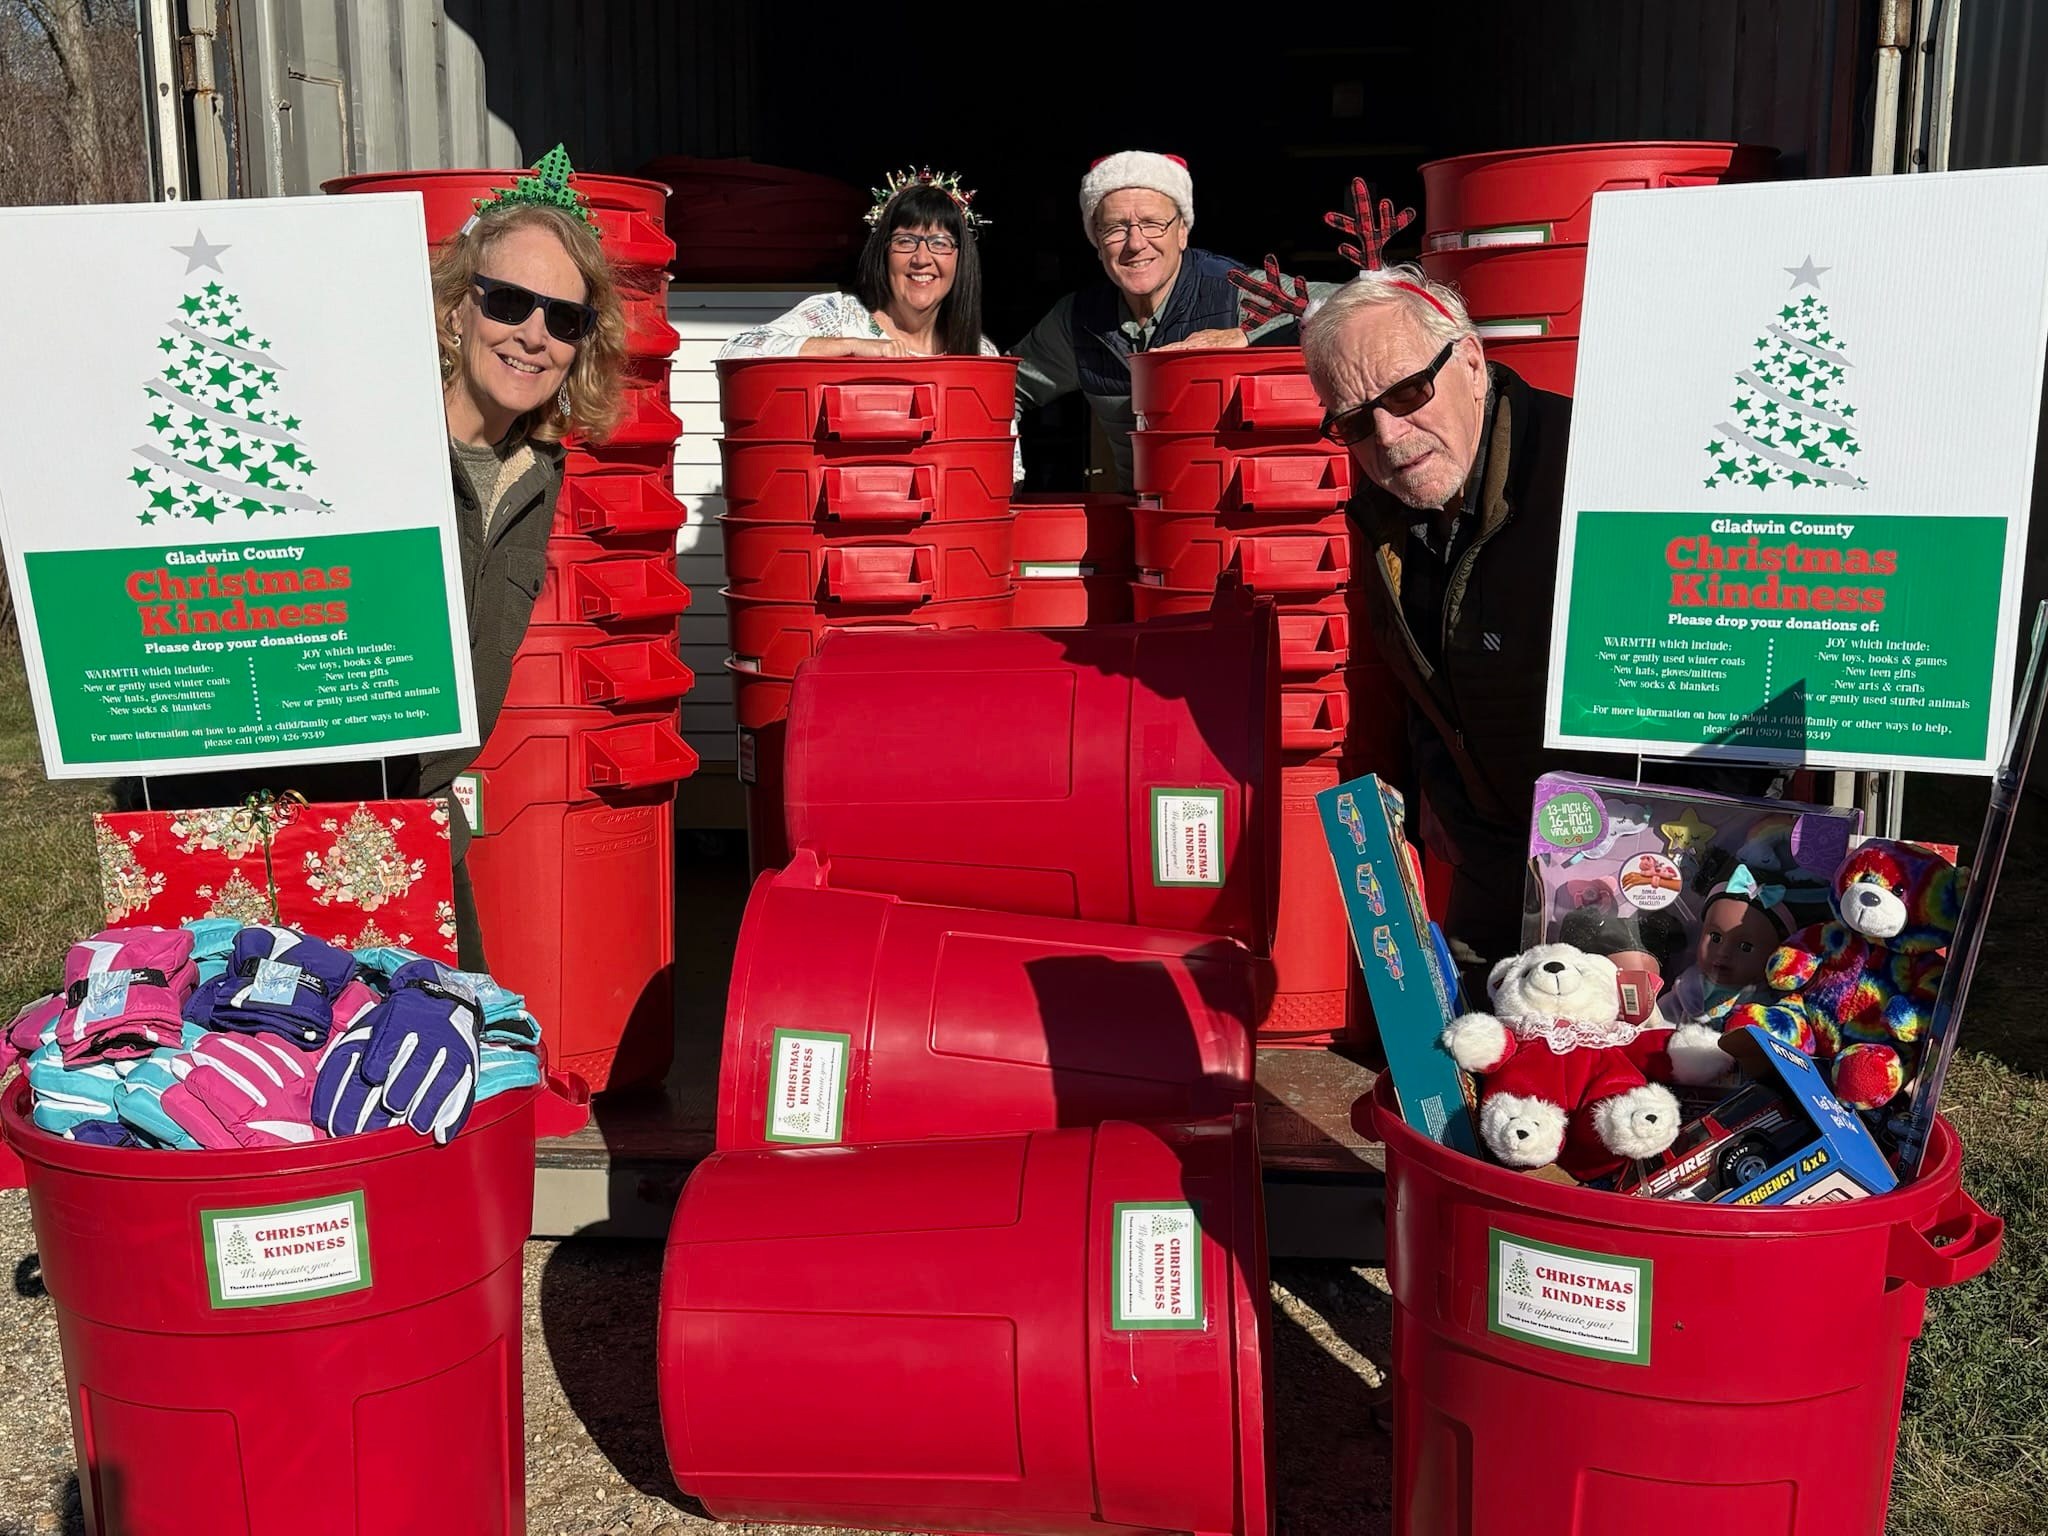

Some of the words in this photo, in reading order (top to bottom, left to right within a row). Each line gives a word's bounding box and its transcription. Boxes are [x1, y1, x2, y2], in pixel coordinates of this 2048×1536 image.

[1711, 519, 1785, 535] Gladwin
[1789, 521, 1854, 539] County
[166, 549, 240, 565] Gladwin
[243, 546, 305, 561] County
[1666, 535, 1898, 575] Christmas
[126, 566, 351, 602] Christmas
[1669, 573, 1885, 612] Kindness
[139, 599, 348, 636] Kindness
[1668, 613, 1713, 626] Please
[1715, 614, 1748, 629] drop
[1751, 619, 1782, 630] your
[1785, 618, 1857, 632] donations
[1860, 620, 1880, 632] of:
[145, 643, 189, 654] Please
[192, 640, 224, 653] drop
[227, 638, 257, 650] your
[260, 632, 328, 647] donations
[330, 630, 348, 641] of:
[302, 649, 321, 660] JOY
[325, 646, 354, 657] which
[357, 643, 396, 654] include:
[1604, 636, 1656, 648] WARMTH
[1659, 639, 1688, 650] which
[1691, 640, 1732, 651] include:
[1825, 637, 1847, 649] JOY
[1851, 639, 1883, 650] which
[1886, 640, 1930, 652] include:
[320, 660, 341, 671] toys,
[343, 658, 371, 668] books
[374, 657, 383, 665] &
[385, 654, 414, 665] games
[1620, 653, 1630, 661] or
[1632, 653, 1660, 665] gently
[1663, 655, 1685, 663] used
[1687, 655, 1718, 665] winter
[1721, 657, 1746, 666] coats
[1842, 653, 1865, 664] toys,
[1868, 653, 1899, 665] books
[1902, 656, 1911, 665] &
[1915, 656, 1948, 667] games
[85, 668, 139, 679] WARMTH
[142, 666, 172, 676] which
[174, 664, 214, 675] include:
[347, 671, 367, 679] teen
[369, 668, 389, 680] gifts
[1635, 666, 1658, 676] hats,
[1661, 668, 1727, 679] gloves/mittens
[1870, 667, 1891, 678] teen
[1894, 668, 1916, 680] gifts
[106, 683, 115, 691] or
[119, 681, 146, 693] gently
[149, 681, 171, 689] used
[174, 678, 203, 687] winter
[206, 677, 231, 686] coats
[340, 683, 359, 692] arts
[361, 681, 370, 690] &
[373, 679, 399, 689] crafts
[1640, 679, 1665, 689] socks
[1668, 681, 1676, 690] &
[1680, 681, 1720, 692] blankets
[1858, 681, 1879, 691] arts
[1882, 682, 1892, 691] &
[1895, 682, 1925, 693] crafts
[124, 693, 149, 702] hats,
[151, 690, 215, 703] gloves/mittens
[304, 699, 314, 707] or
[317, 695, 344, 708] gently
[346, 694, 368, 703] used
[370, 690, 402, 701] stuffed
[404, 686, 440, 697] animals
[1816, 692, 1827, 701] or
[1830, 693, 1860, 706] gently
[1863, 695, 1887, 705] used
[1890, 695, 1925, 707] stuffed
[1928, 697, 1971, 709] animals
[132, 705, 157, 714] socks
[160, 704, 169, 713] &
[172, 702, 212, 712] blankets
[91, 733, 107, 742] For
[110, 733, 132, 741] more
[135, 729, 189, 740] information
[191, 728, 203, 736] on
[205, 727, 224, 735] how
[227, 726, 236, 734] to
[239, 723, 264, 735] adopt
[275, 719, 329, 730] child/family
[344, 715, 368, 725] other
[371, 712, 392, 722] ways
[394, 711, 403, 719] to
[406, 708, 429, 719] help.
[1593, 705, 1608, 714] For
[1611, 707, 1634, 715] more
[1636, 707, 1690, 719] information
[1693, 712, 1704, 720] on
[1708, 711, 1726, 721] how
[1729, 712, 1739, 721] to
[1742, 713, 1768, 725] adopt
[1780, 715, 1838, 729] child/family
[1841, 719, 1853, 728] or
[1856, 719, 1882, 730] other
[1885, 722, 1909, 732] ways
[1911, 722, 1922, 731] to
[1925, 723, 1952, 735] help.
[204, 737, 232, 748] please
[235, 736, 252, 745] call
[255, 731, 280, 745] (989)
[1703, 724, 1733, 736] please
[1735, 725, 1752, 736] call
[1546, 803, 1580, 815] 13-INCH
[1582, 802, 1591, 812] &
[1572, 825, 1593, 834] DOLLS
[1185, 826, 1195, 876] KINDNESS
[1198, 823, 1208, 879] CHRISTMAS
[786, 1042, 801, 1109] CHRISTMAS
[800, 1048, 813, 1105] KINDNESS
[1668, 1152, 1711, 1183] FIRE
[1726, 1146, 1749, 1170] NYLINT
[255, 1217, 350, 1242] CHRISTMAS
[264, 1236, 346, 1258] KINDNESS
[241, 1267, 257, 1279] We
[258, 1264, 309, 1280] appreciate
[1154, 1243, 1165, 1310] KINDNESS
[1170, 1238, 1181, 1314] CHRISTMAS
[1535, 1266, 1633, 1295] CHRISTMAS
[1542, 1286, 1626, 1313] KINDNESS
[1517, 1301, 1534, 1312] We
[1534, 1308, 1585, 1325] appreciate
[1583, 1320, 1614, 1330] you!
